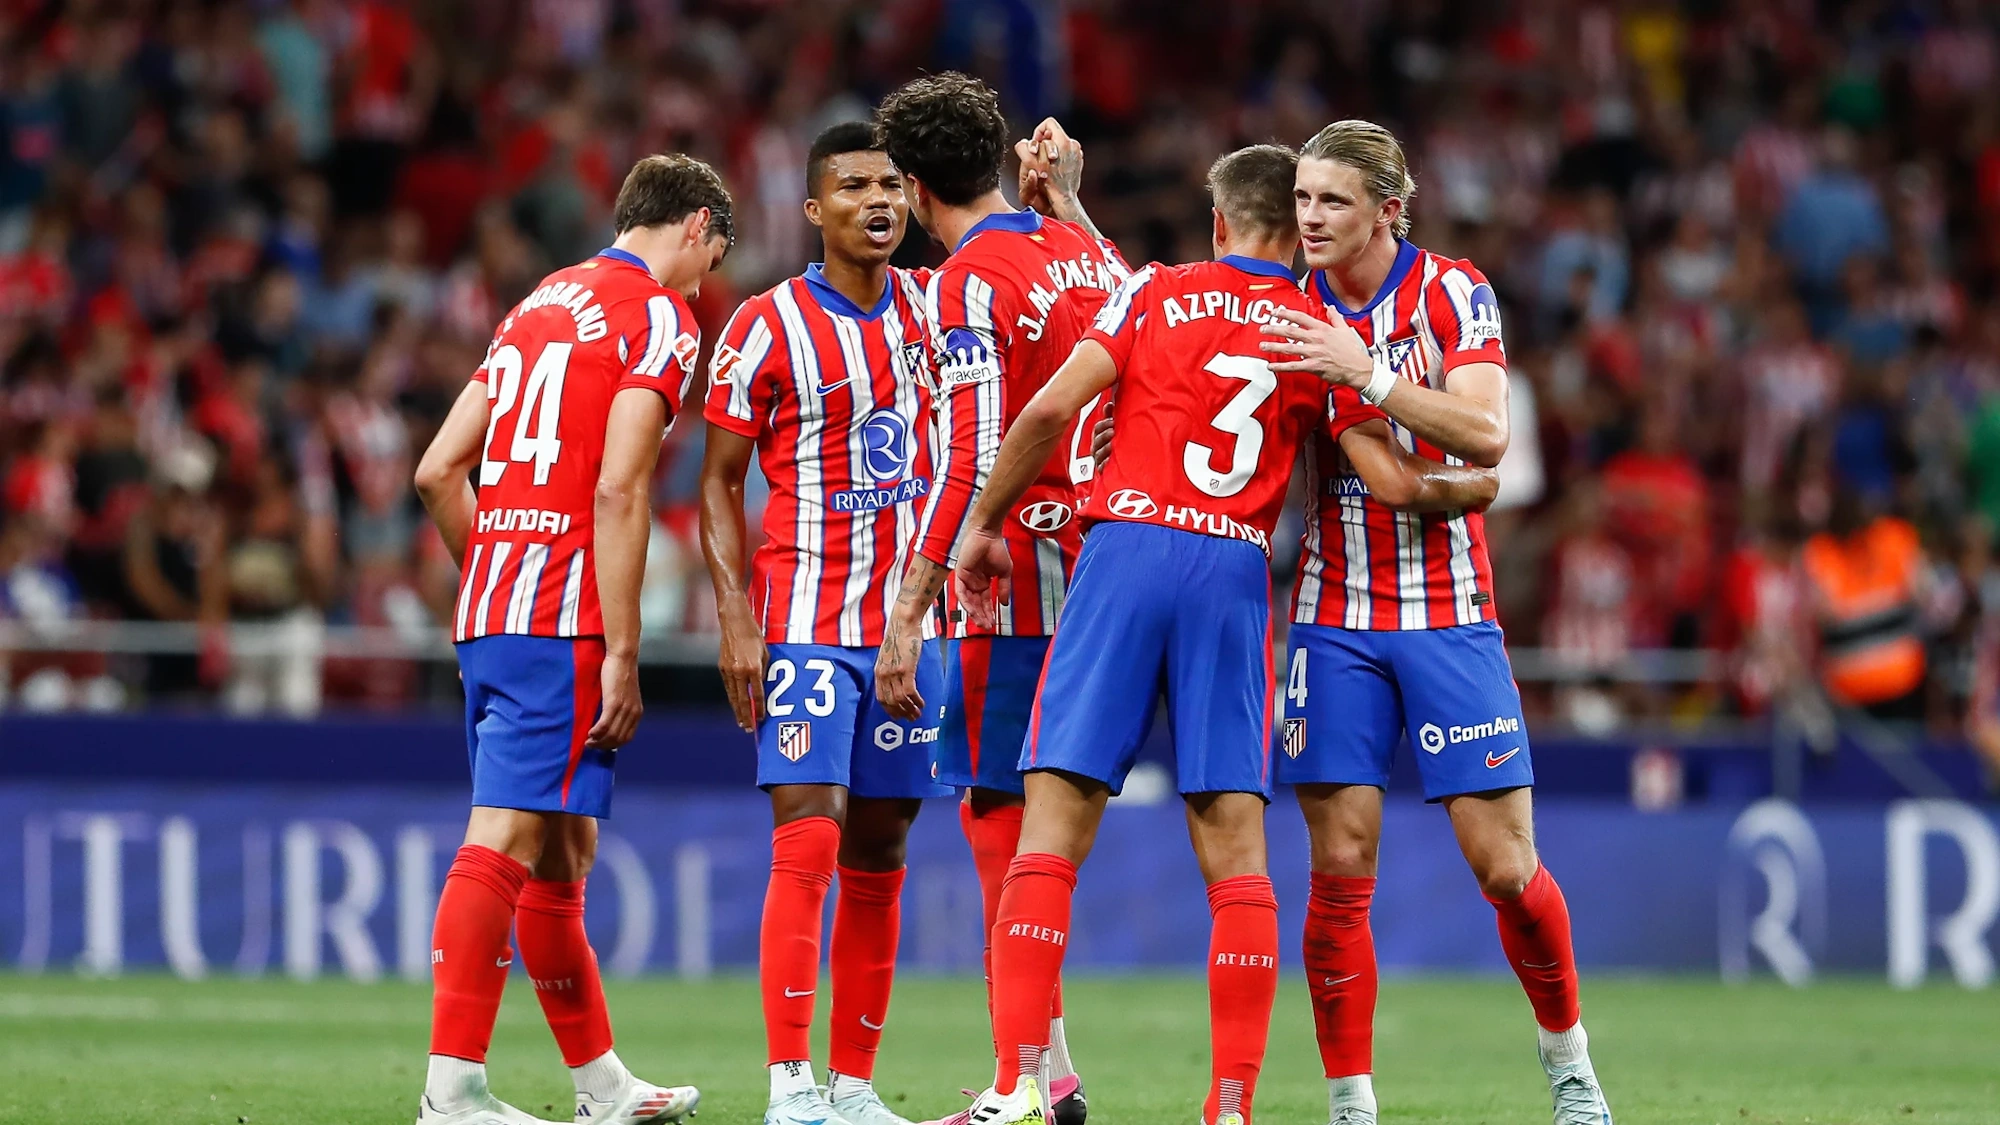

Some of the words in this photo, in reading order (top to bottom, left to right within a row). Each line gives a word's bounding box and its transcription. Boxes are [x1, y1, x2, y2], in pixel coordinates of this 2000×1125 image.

[946, 367, 992, 383] kraken
[479, 340, 574, 488] 24
[1183, 351, 1279, 498] 3
[901, 478, 926, 500] AR
[766, 658, 836, 718] 23
[1288, 647, 1309, 708] 4
[1448, 716, 1520, 744] ComAve
[1008, 923, 1066, 947] ATLETI
[1215, 952, 1275, 969] ATLETI
